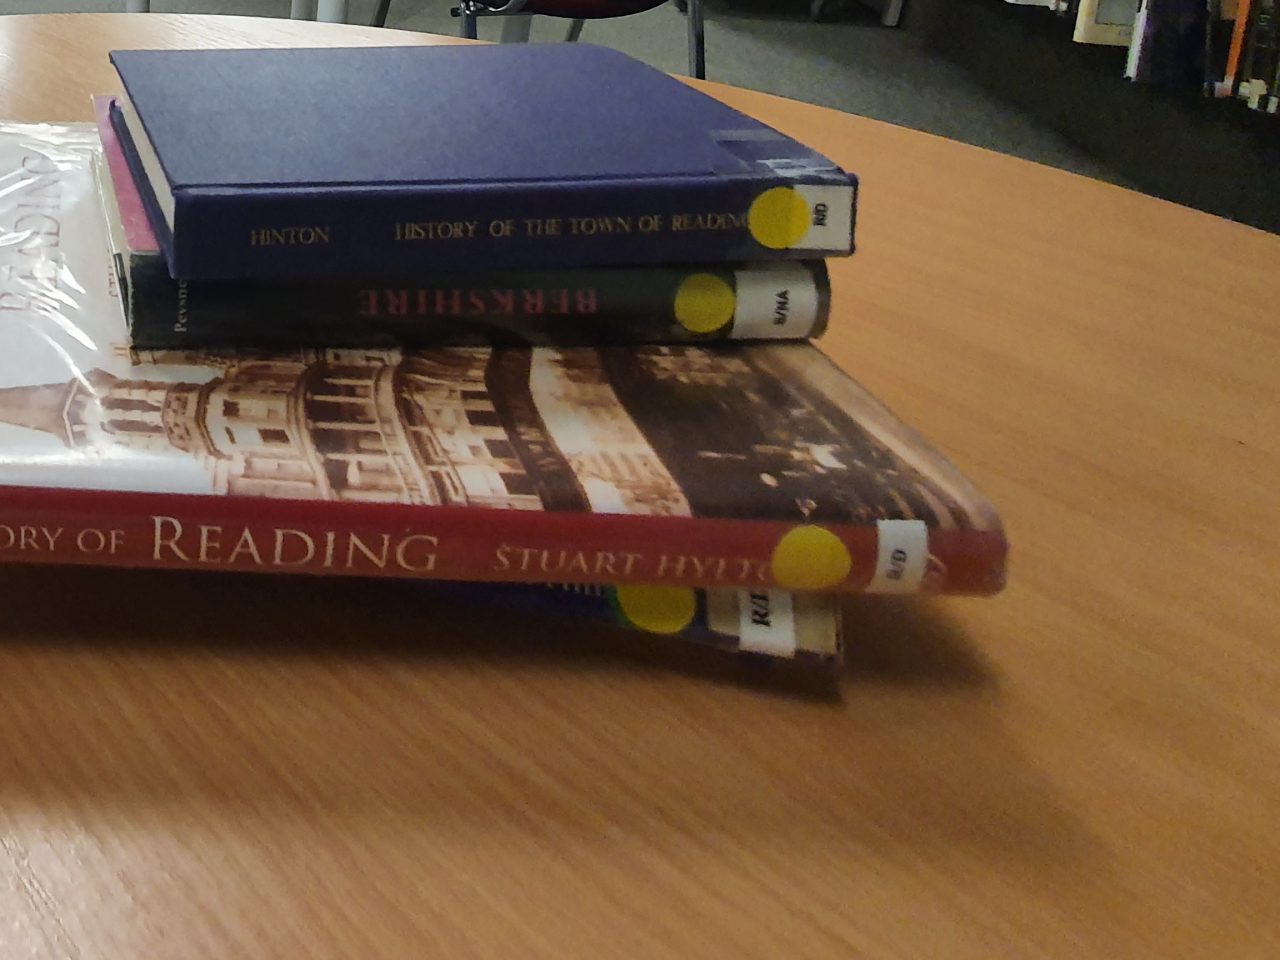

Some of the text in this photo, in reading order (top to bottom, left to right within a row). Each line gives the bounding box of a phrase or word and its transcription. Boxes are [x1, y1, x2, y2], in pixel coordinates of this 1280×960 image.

[250, 226, 331, 246] HINTON
[394, 220, 480, 241] HISTORY
[488, 219, 515, 239] OF
[524, 218, 562, 236] THE
[568, 216, 633, 235] TOWN
[638, 214, 664, 232] OF
[358, 287, 598, 316] BERKSHIRE
[77, 528, 125, 553] OF
[152, 515, 439, 572] READING
[493, 544, 642, 575] STUART
[657, 554, 772, 581] HYLTO
